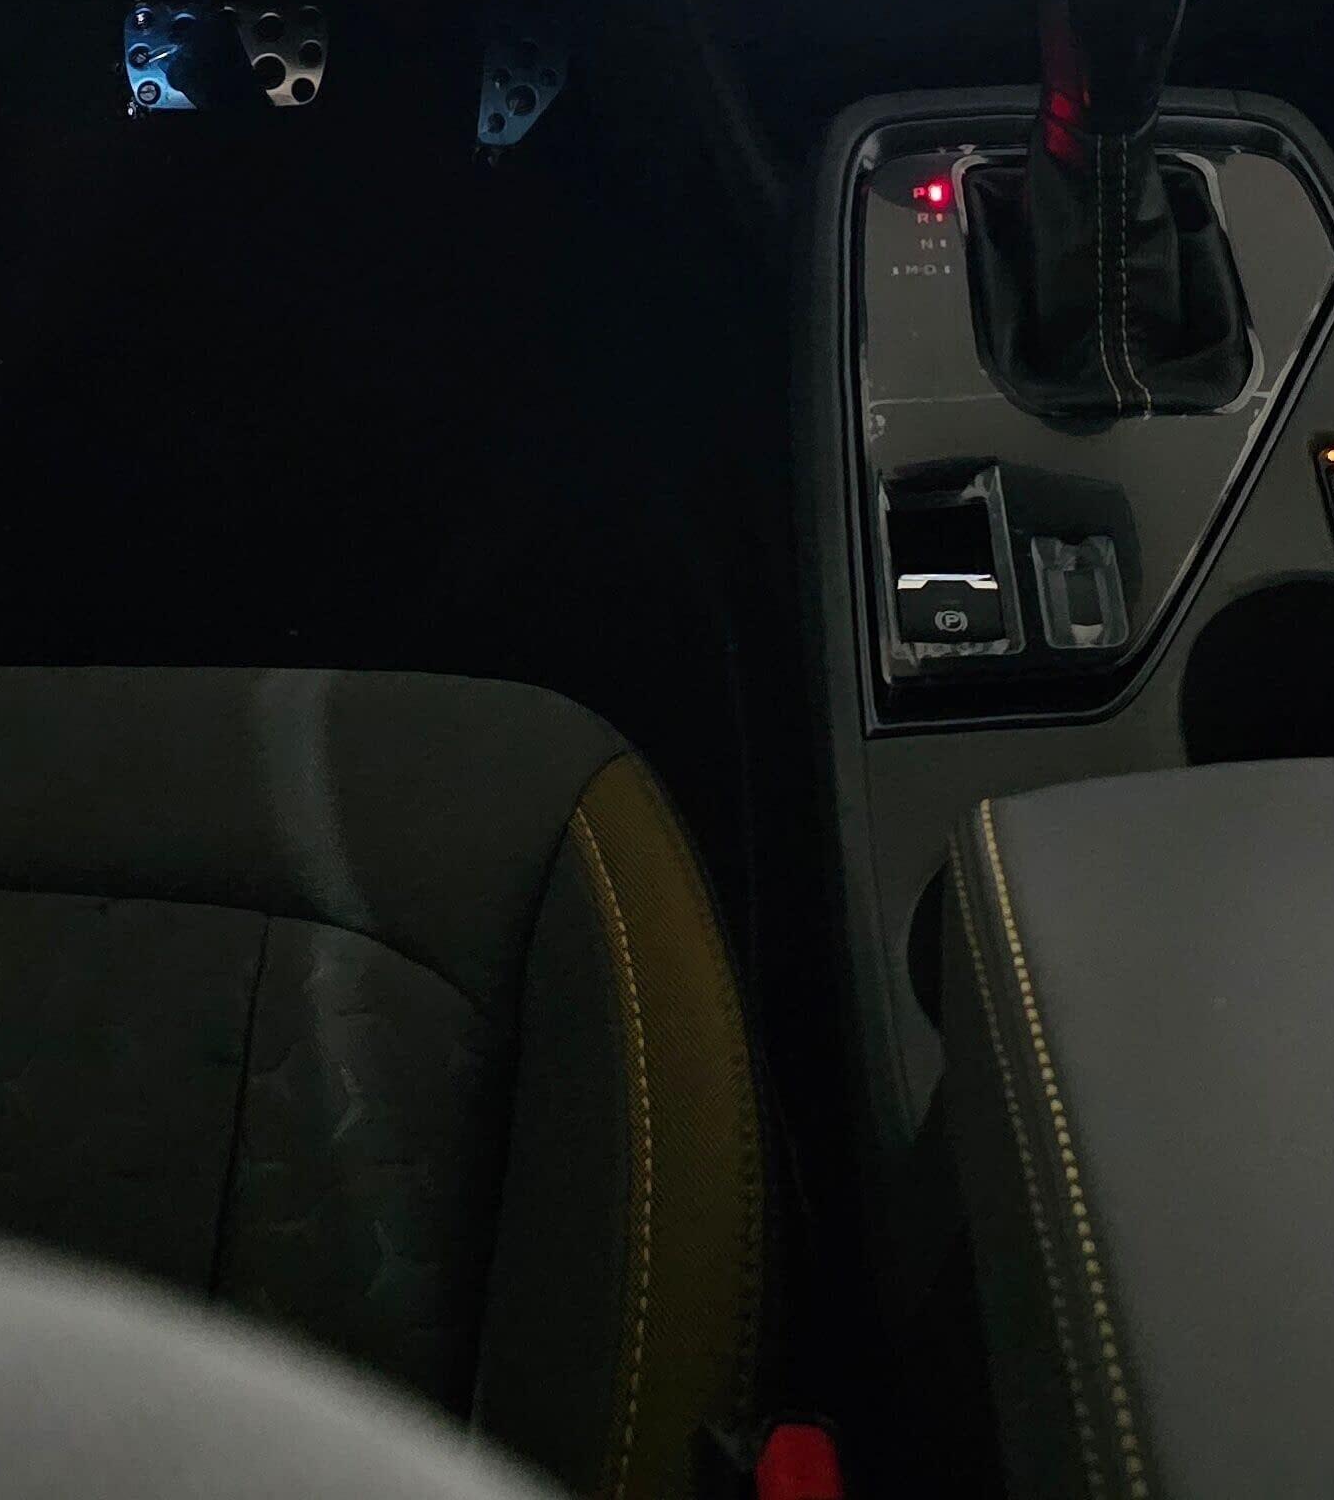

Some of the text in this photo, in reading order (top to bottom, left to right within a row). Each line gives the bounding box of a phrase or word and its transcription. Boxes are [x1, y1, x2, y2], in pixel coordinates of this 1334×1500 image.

[913, 186, 925, 198] P
[918, 213, 929, 224] R
[920, 237, 934, 250] N
